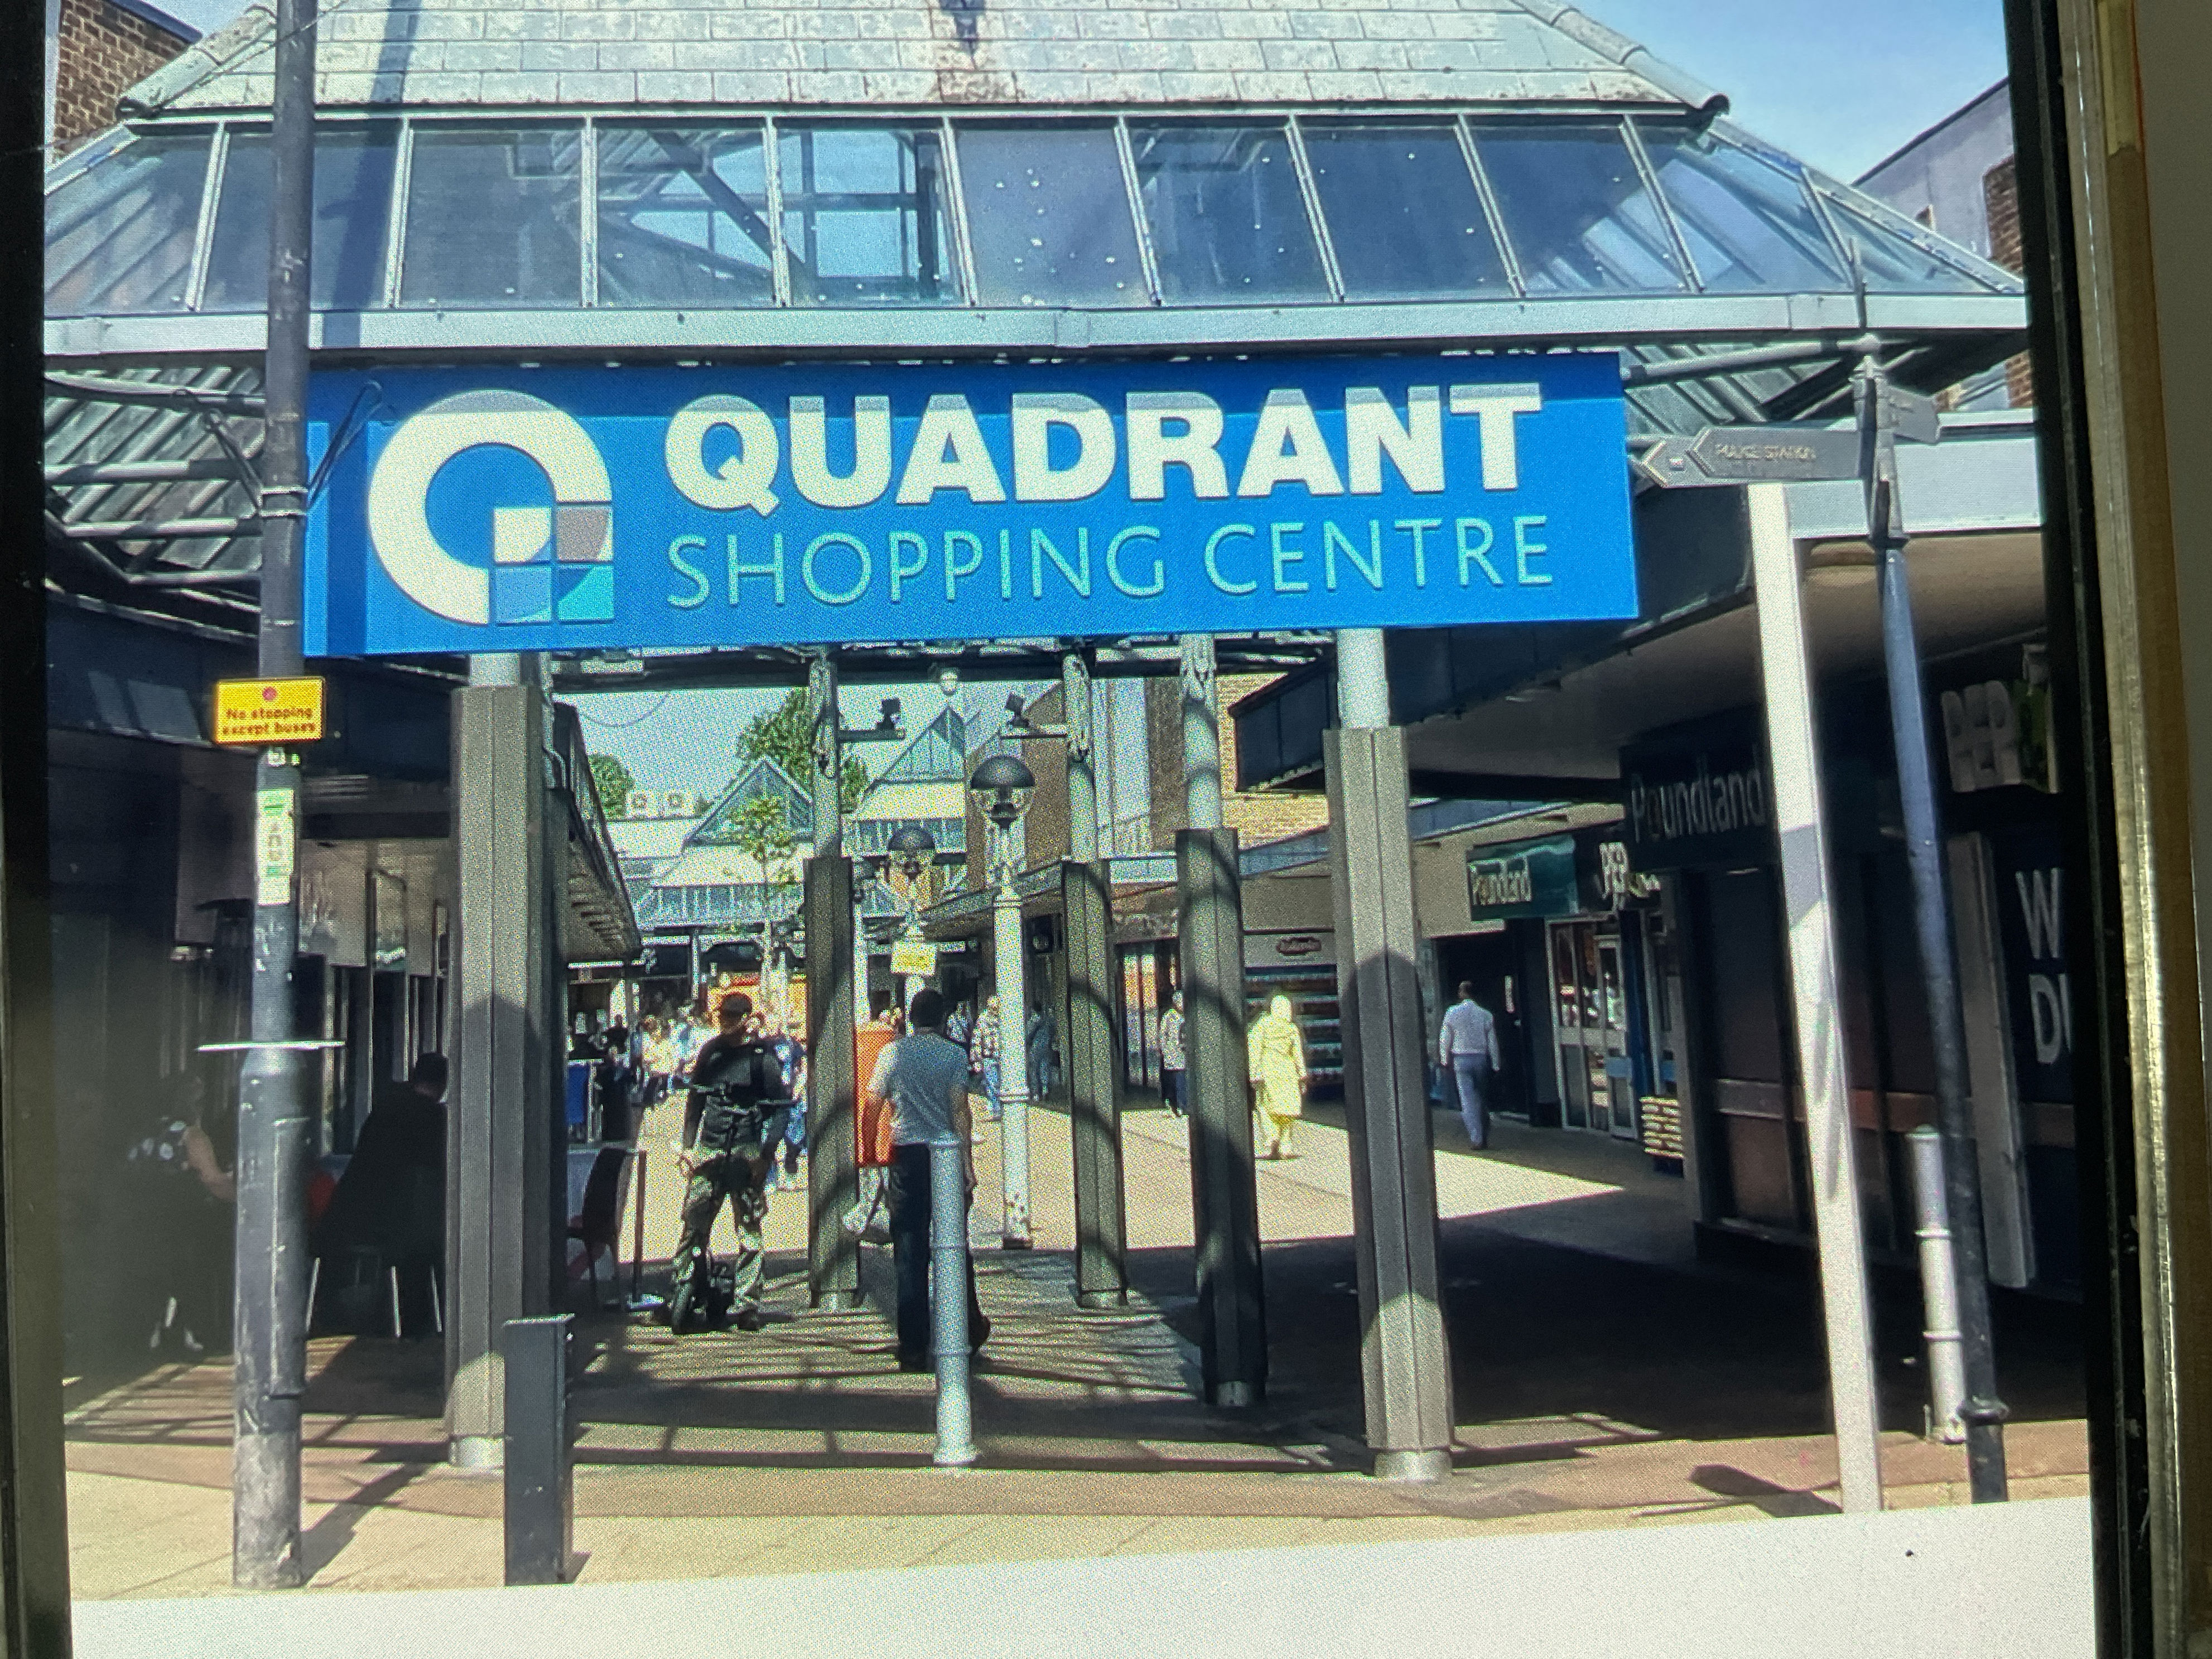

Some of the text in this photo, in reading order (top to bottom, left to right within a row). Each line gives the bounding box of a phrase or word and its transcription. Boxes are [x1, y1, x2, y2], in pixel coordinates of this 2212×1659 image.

[665, 382, 1543, 517] QUADRANT
[667, 514, 1553, 609] SHOPPING CENTRE
[222, 722, 316, 735] except buses
[225, 706, 313, 721] No stopping
[1631, 744, 1766, 843] Poundland
